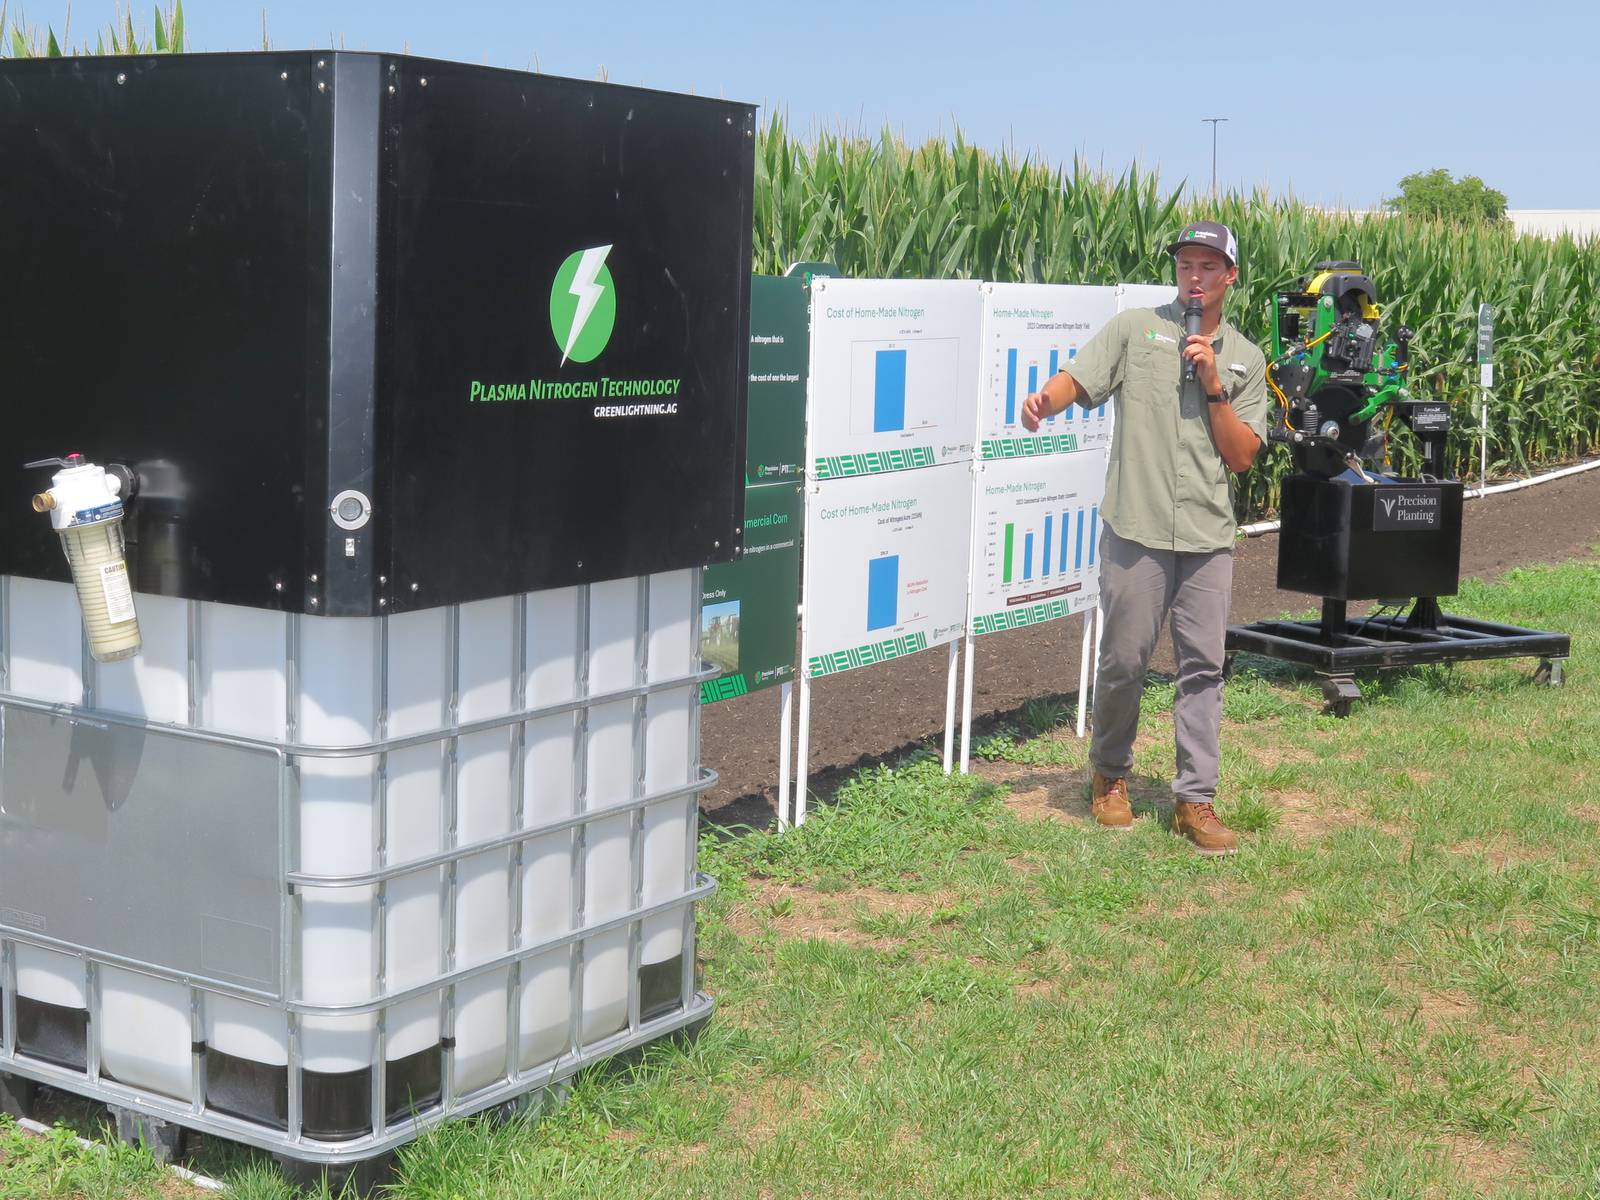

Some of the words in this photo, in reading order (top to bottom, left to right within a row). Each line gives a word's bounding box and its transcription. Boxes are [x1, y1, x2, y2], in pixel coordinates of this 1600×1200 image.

[826, 307, 845, 319] Cost
[845, 307, 854, 318] of
[854, 306, 897, 318] Home-Made
[898, 306, 925, 320] Nitrogen
[993, 308, 1030, 319] Home-Made
[1030, 308, 1054, 320] Nitrogen
[755, 335, 772, 345] nitrogen
[772, 335, 780, 343] that
[470, 381, 526, 401] PLASMA
[529, 379, 598, 400] NITROGEN
[601, 377, 681, 397] TECHNOLOGY
[594, 403, 678, 418] GREENLIGHTNING.AG
[985, 483, 1023, 495] Home-Made
[1023, 481, 1047, 493] Nitrogen
[1397, 494, 1437, 506] Precision
[820, 508, 839, 520] Cost
[840, 506, 848, 518] of
[848, 502, 891, 516] Home-Made
[891, 498, 918, 511] Nitrogen
[1397, 509, 1435, 524] Planting
[715, 589, 727, 599] Only
